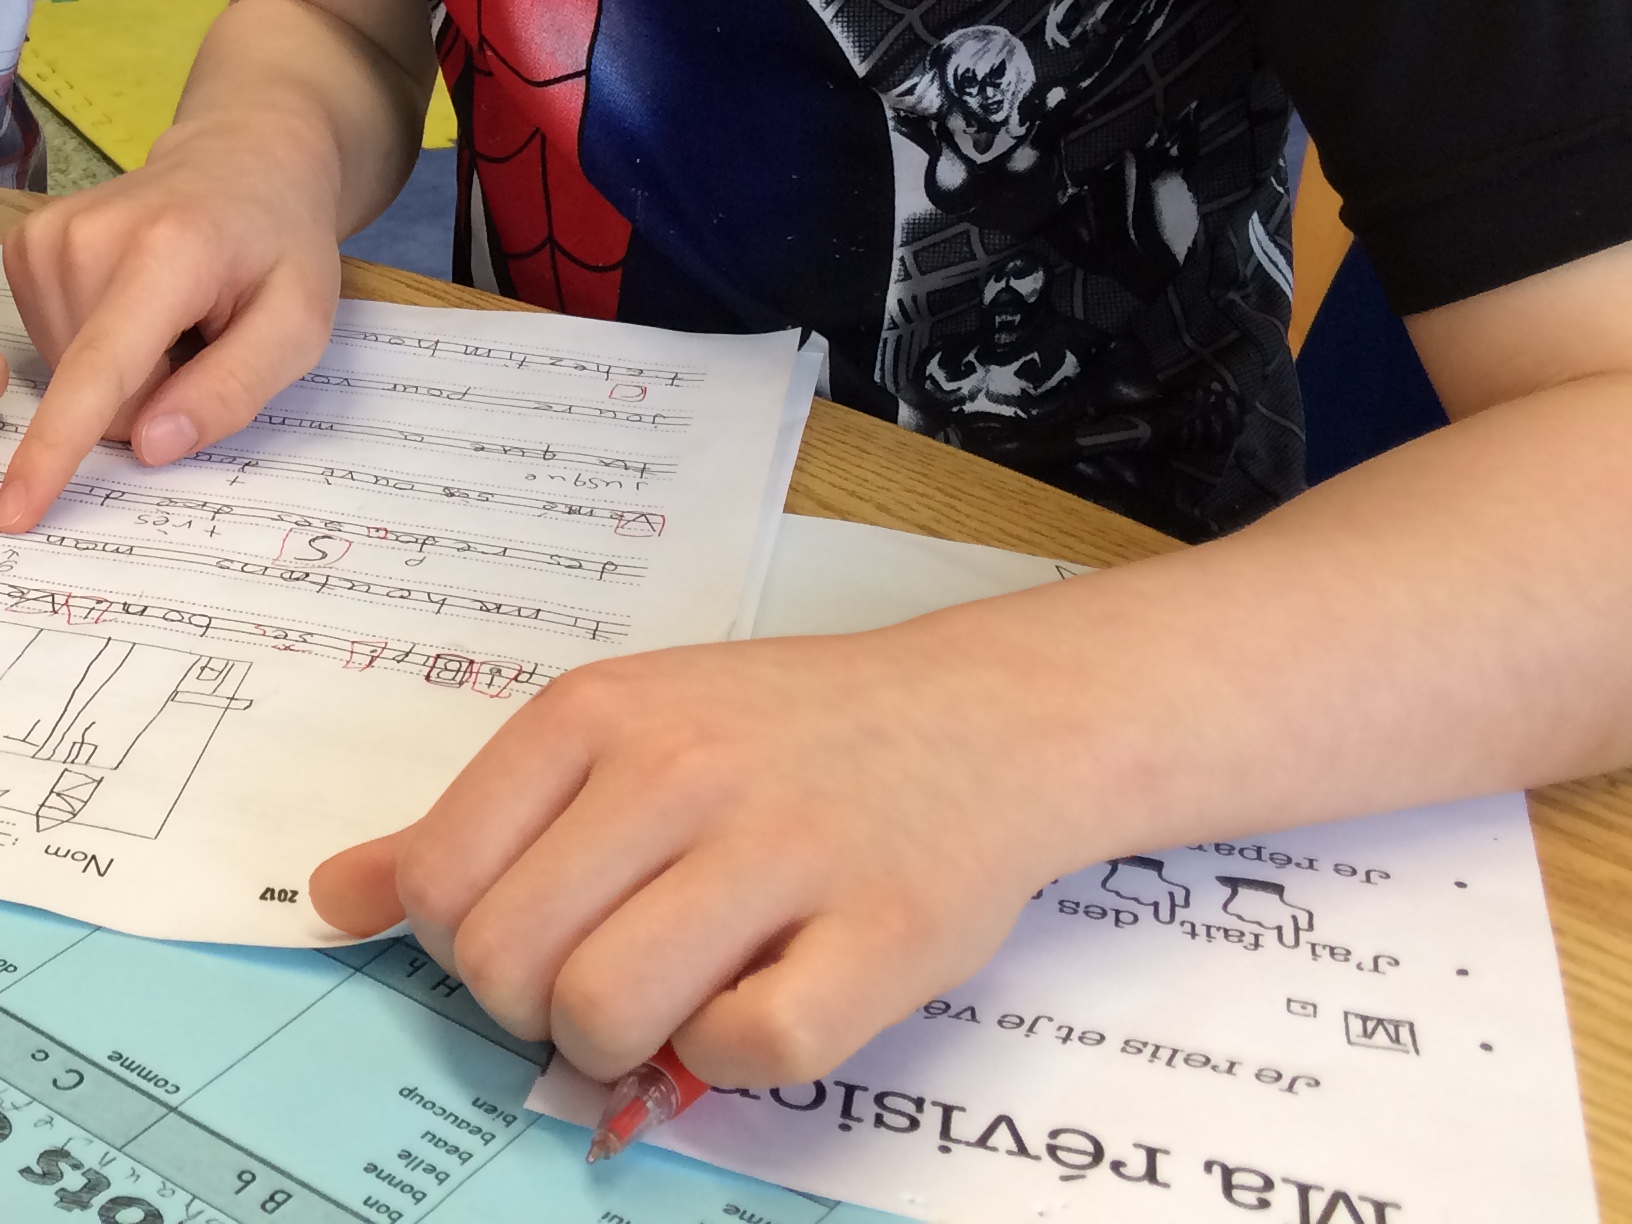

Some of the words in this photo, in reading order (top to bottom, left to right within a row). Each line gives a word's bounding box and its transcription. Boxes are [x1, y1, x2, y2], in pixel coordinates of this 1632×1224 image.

[380, 382, 472, 401] pour
[524, 472, 648, 492] jusque
[42, 843, 115, 879] Nom
[1332, 862, 1391, 886] Je
[258, 886, 299, 906] 2017
[1057, 898, 1140, 929] des
[1179, 919, 1266, 953] fait
[1304, 940, 1401, 975] J'ai
[995, 1012, 1055, 1039] je
[1054, 1024, 1106, 1050] et
[106, 1049, 181, 1098] comme
[1119, 1038, 1242, 1077] relis
[1253, 1066, 1321, 1096] Je
[397, 1085, 498, 1148] beaucoup
[470, 1095, 519, 1131] bien
[419, 1129, 474, 1166] beau
[362, 1161, 428, 1206] bonne
[396, 1149, 451, 1187] belle
[361, 1194, 405, 1224] bon
